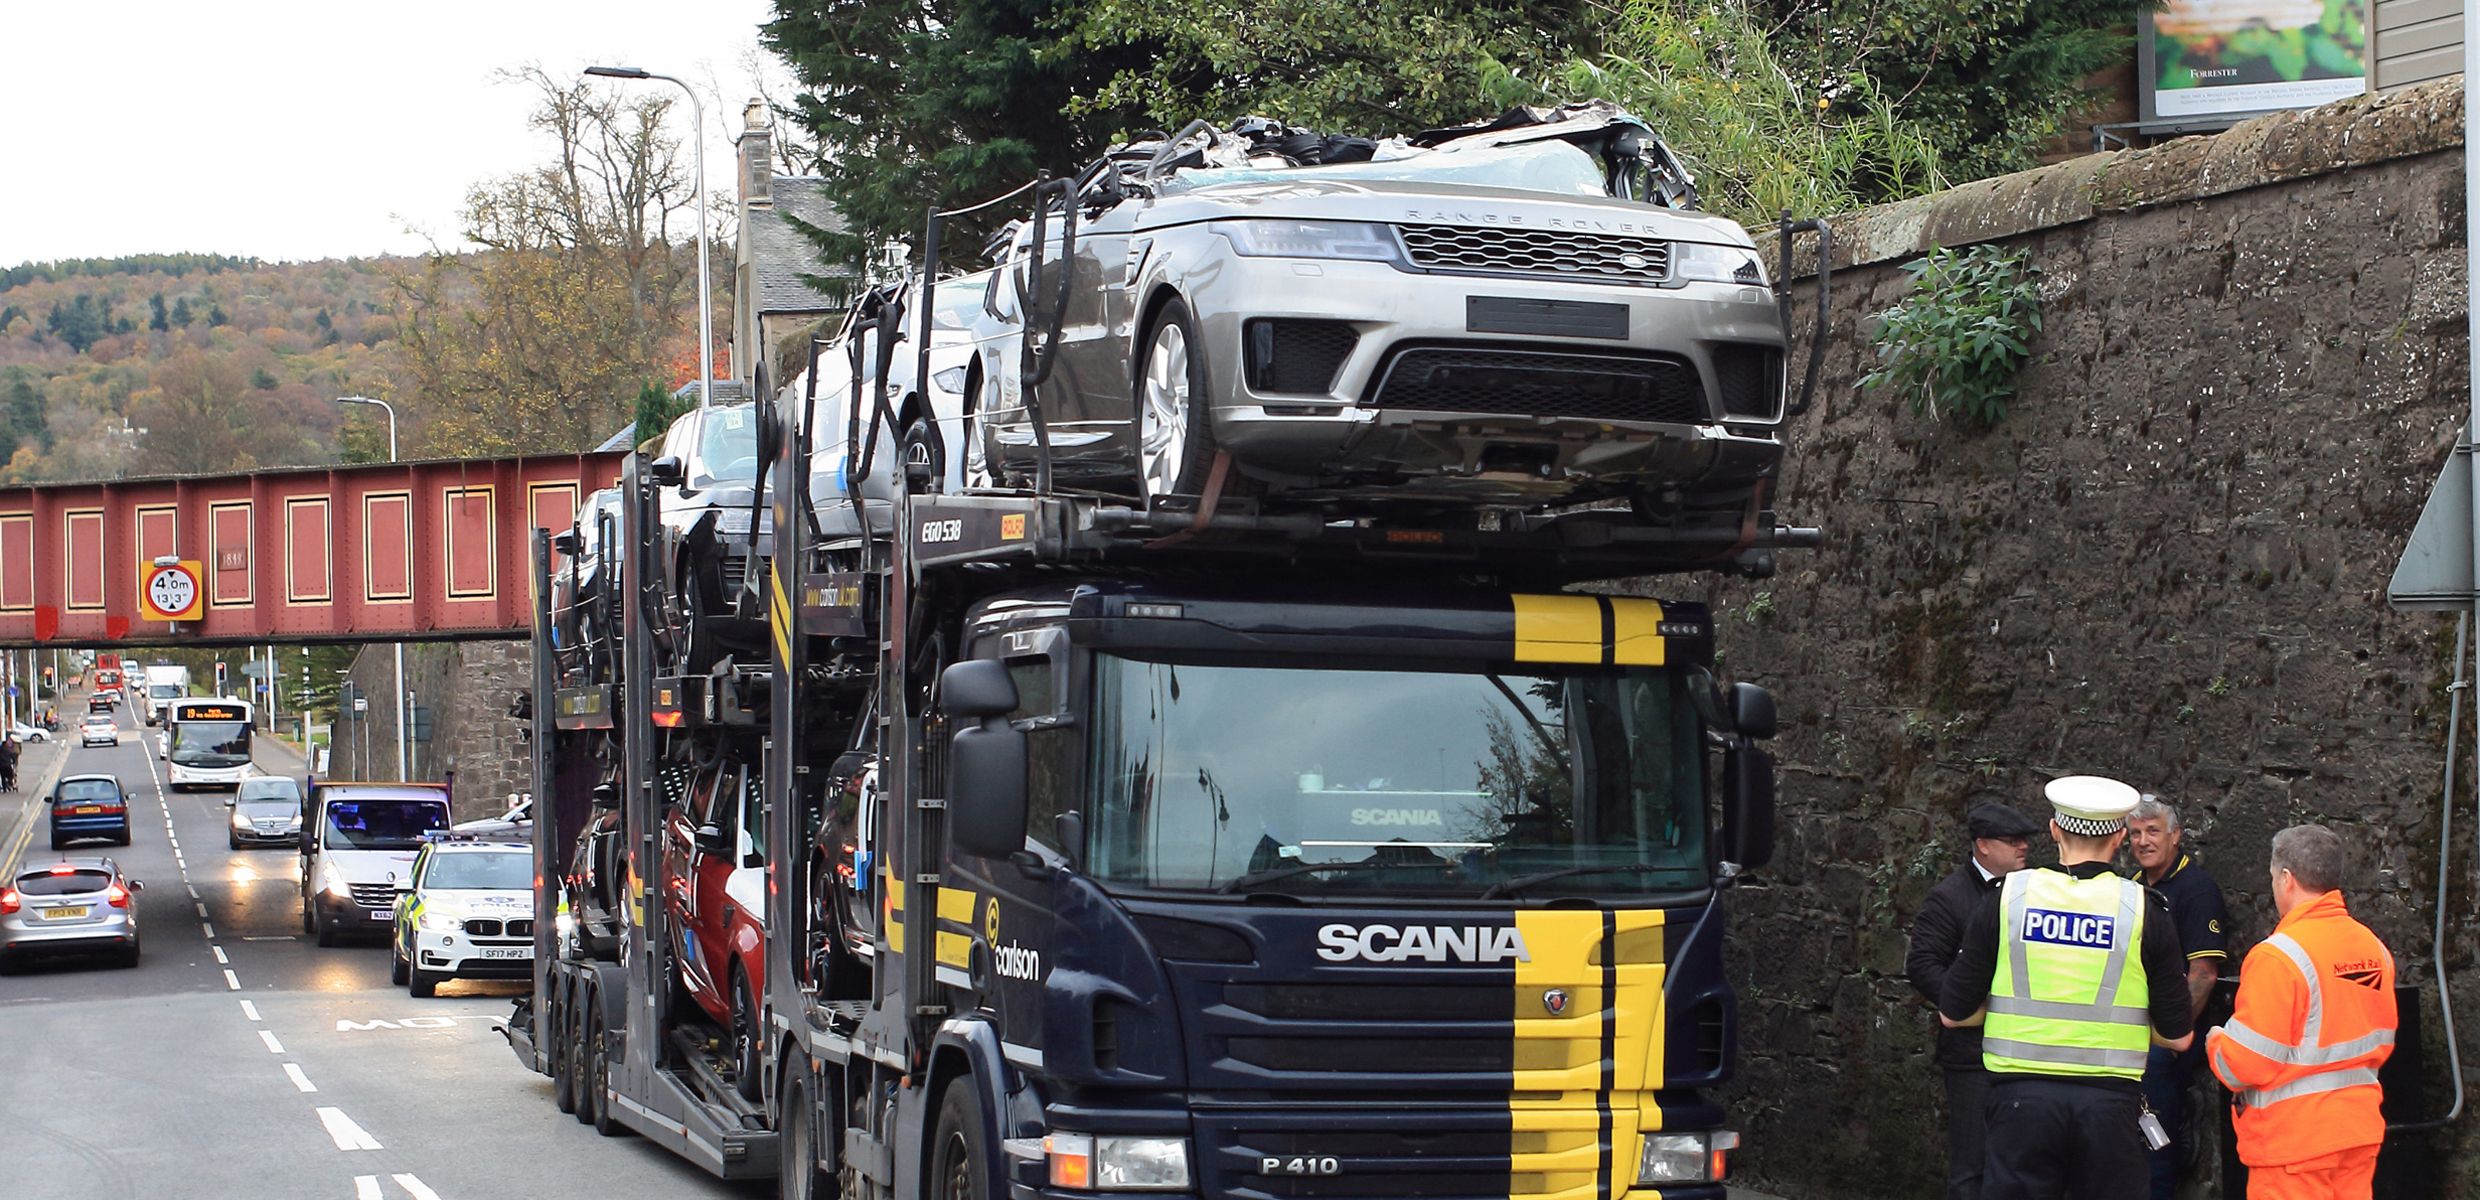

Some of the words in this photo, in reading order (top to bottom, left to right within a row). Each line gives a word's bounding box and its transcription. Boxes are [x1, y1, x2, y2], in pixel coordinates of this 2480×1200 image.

[2190, 68, 2238, 79] FORRESTER
[1405, 210, 1523, 225] RANGE
[1549, 217, 1659, 235] ROVER
[922, 521, 942, 543] EGO
[942, 519, 962, 542] 538
[155, 576, 189, 589] 4.0m
[187, 708, 196, 719] 19
[1351, 808, 1443, 826] SCANIA
[2025, 911, 2112, 945] POLICE
[1316, 923, 1532, 963] SCANIA
[995, 939, 1040, 981] carlson
[1262, 1158, 1280, 1175] P
[1286, 1157, 1339, 1174] 410
